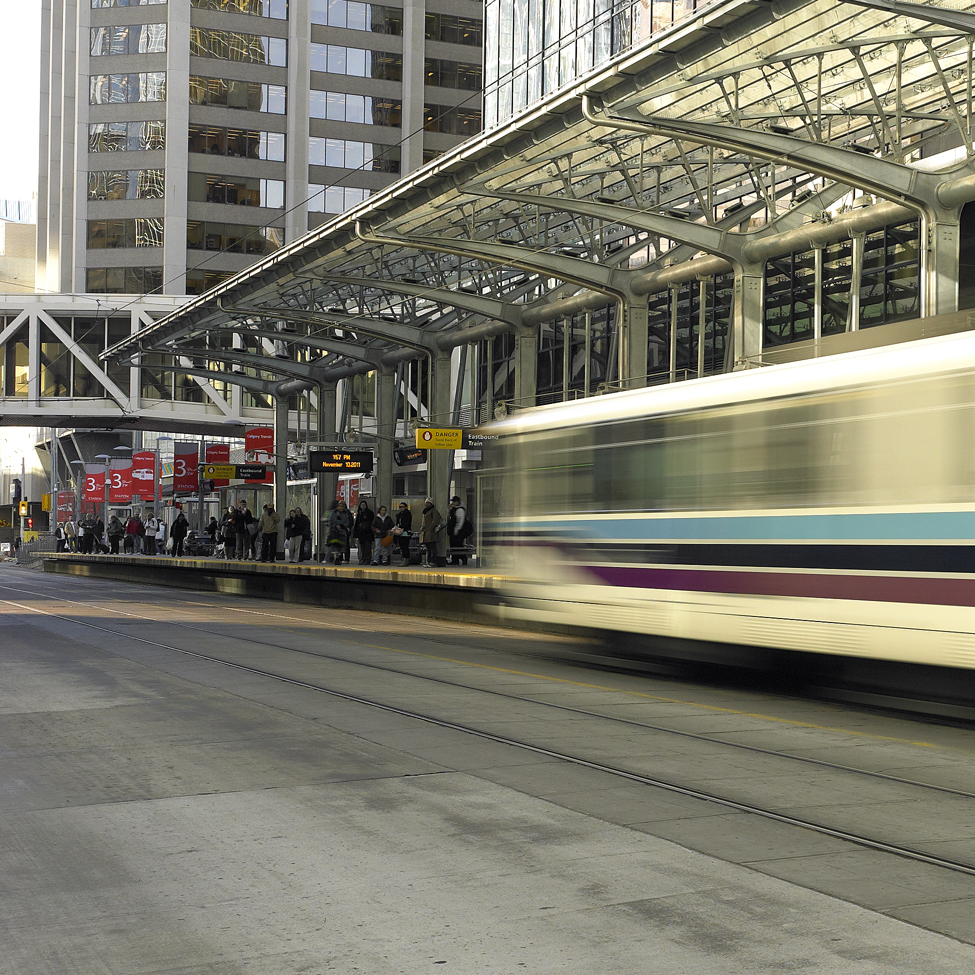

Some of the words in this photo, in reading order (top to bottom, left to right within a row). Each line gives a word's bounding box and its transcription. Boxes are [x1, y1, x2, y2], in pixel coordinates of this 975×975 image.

[175, 459, 186, 477] 3
[86, 477, 96, 492] 3
[112, 473, 122, 488] 3
